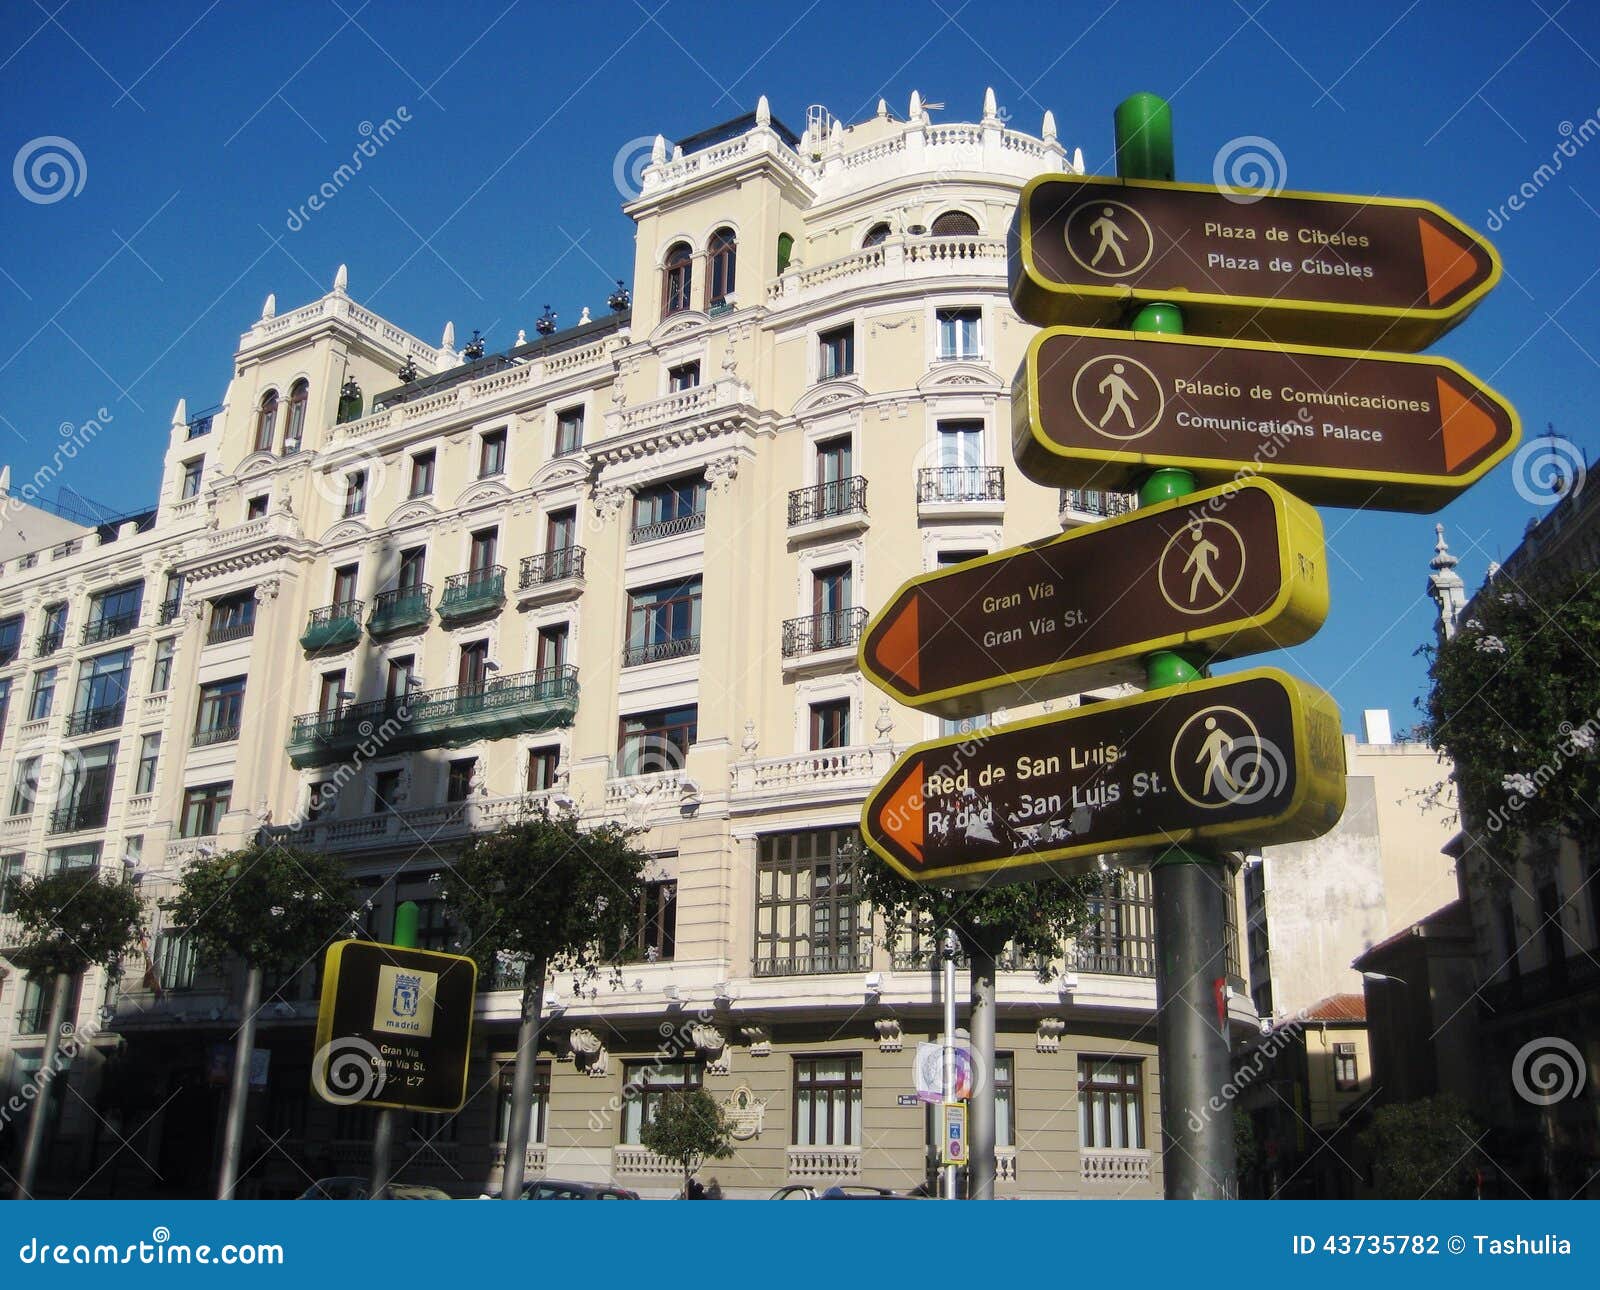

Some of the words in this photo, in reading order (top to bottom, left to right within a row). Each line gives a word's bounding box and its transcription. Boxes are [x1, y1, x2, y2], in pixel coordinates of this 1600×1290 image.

[1204, 222, 1257, 240] Plaza
[1265, 227, 1289, 242] de
[1298, 229, 1369, 248] Cibeles
[1207, 253, 1260, 271] Plaza
[1268, 258, 1293, 273] de
[1301, 259, 1373, 278] Cibeles
[1174, 379, 1241, 398] Palacio
[1250, 385, 1273, 400] de
[1280, 387, 1431, 413] Comunicaciones
[1322, 423, 1383, 442] Palace
[982, 593, 1021, 613] Gran
[1028, 582, 1055, 601] Vía
[983, 628, 1022, 648] Gran
[1029, 617, 1056, 636] Vía
[1064, 609, 1088, 628] St.
[928, 768, 969, 798] Red
[978, 764, 1006, 787] de
[1016, 756, 1060, 780] San
[1070, 742, 1119, 770] Luis
[1018, 794, 1061, 819] San
[1071, 780, 1121, 809] Luis
[1133, 771, 1167, 797] St.
[386, 1020, 420, 1031] madrid
[380, 1044, 402, 1056] Gran
[370, 1056, 393, 1068] Gran
[413, 1061, 426, 1072] St.
